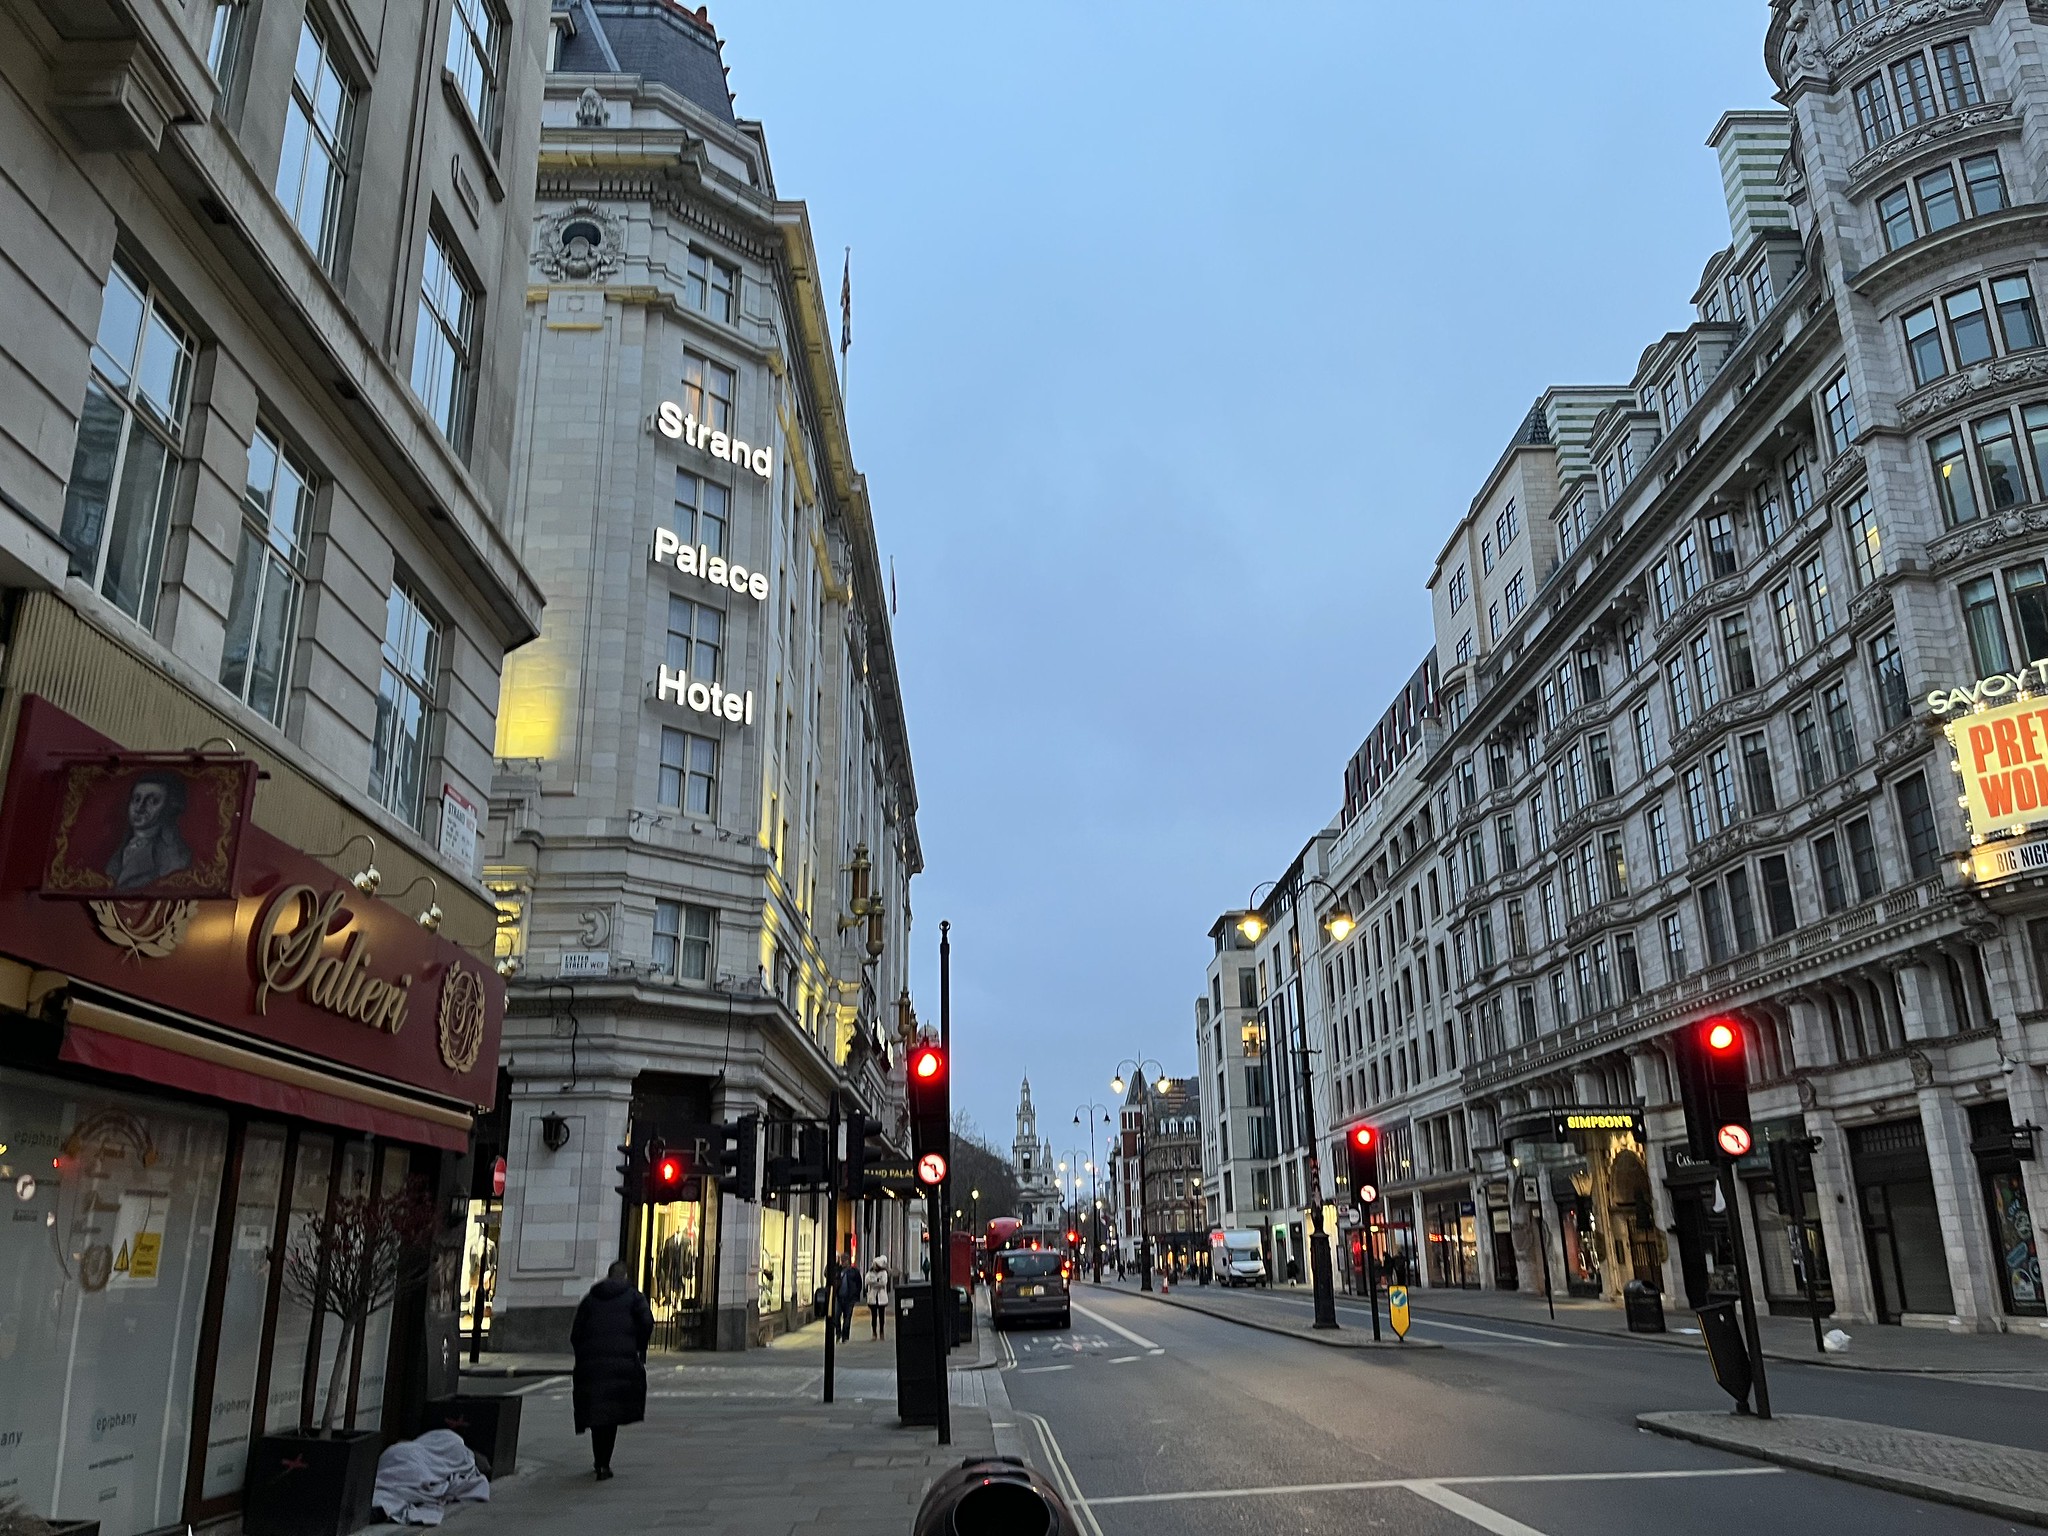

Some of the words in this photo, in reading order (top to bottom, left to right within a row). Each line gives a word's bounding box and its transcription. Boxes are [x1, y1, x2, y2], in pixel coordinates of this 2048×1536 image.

[658, 401, 772, 479] Strand
[655, 526, 769, 601] Palace
[658, 664, 752, 725] Hotel
[1928, 669, 2028, 714] SAVOY
[1996, 850, 2017, 873] BIG
[257, 884, 412, 1035] Salieri
[565, 961, 588, 969] STREET
[1567, 1115, 1633, 1129] SIMPSON'S
[97, 1411, 137, 1433] epiphany
